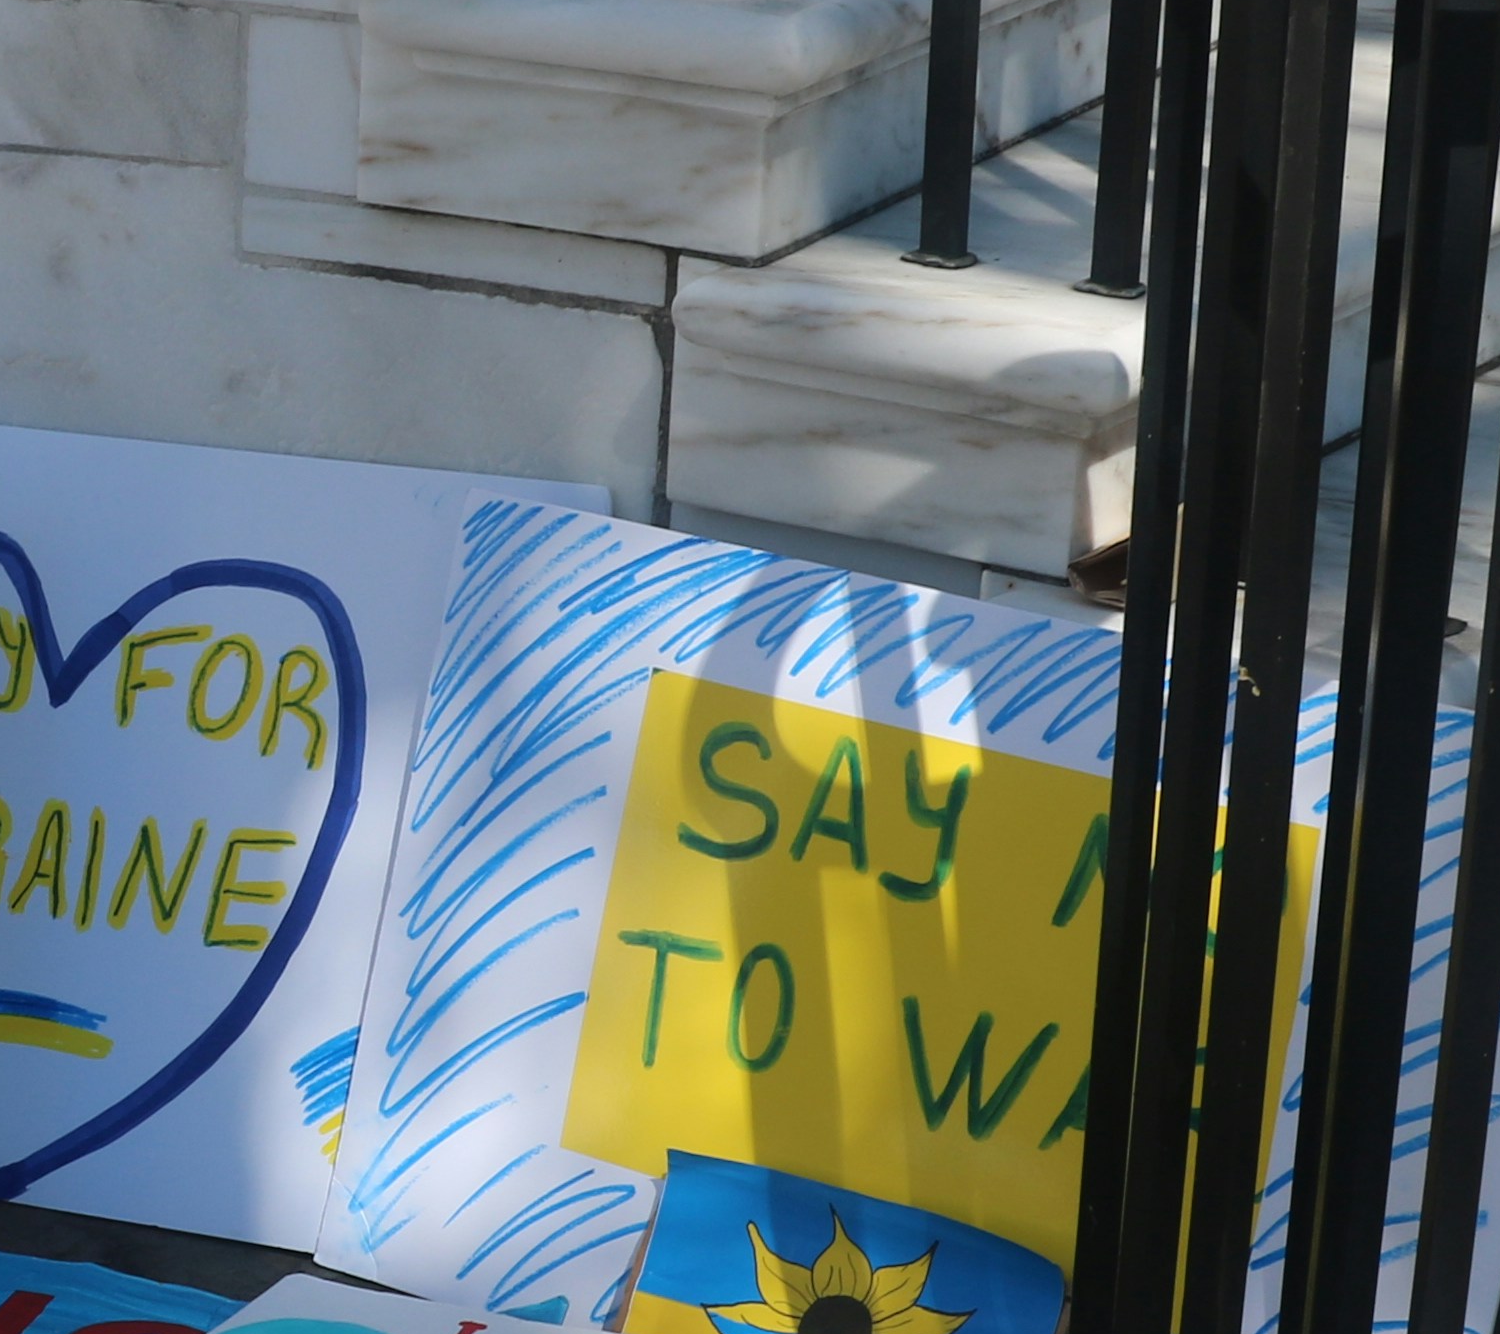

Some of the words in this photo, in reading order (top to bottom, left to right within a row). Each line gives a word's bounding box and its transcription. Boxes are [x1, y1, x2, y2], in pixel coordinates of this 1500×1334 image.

[114, 624, 330, 771] FOR
[678, 722, 971, 901] SAY
[618, 928, 798, 1073] TO
